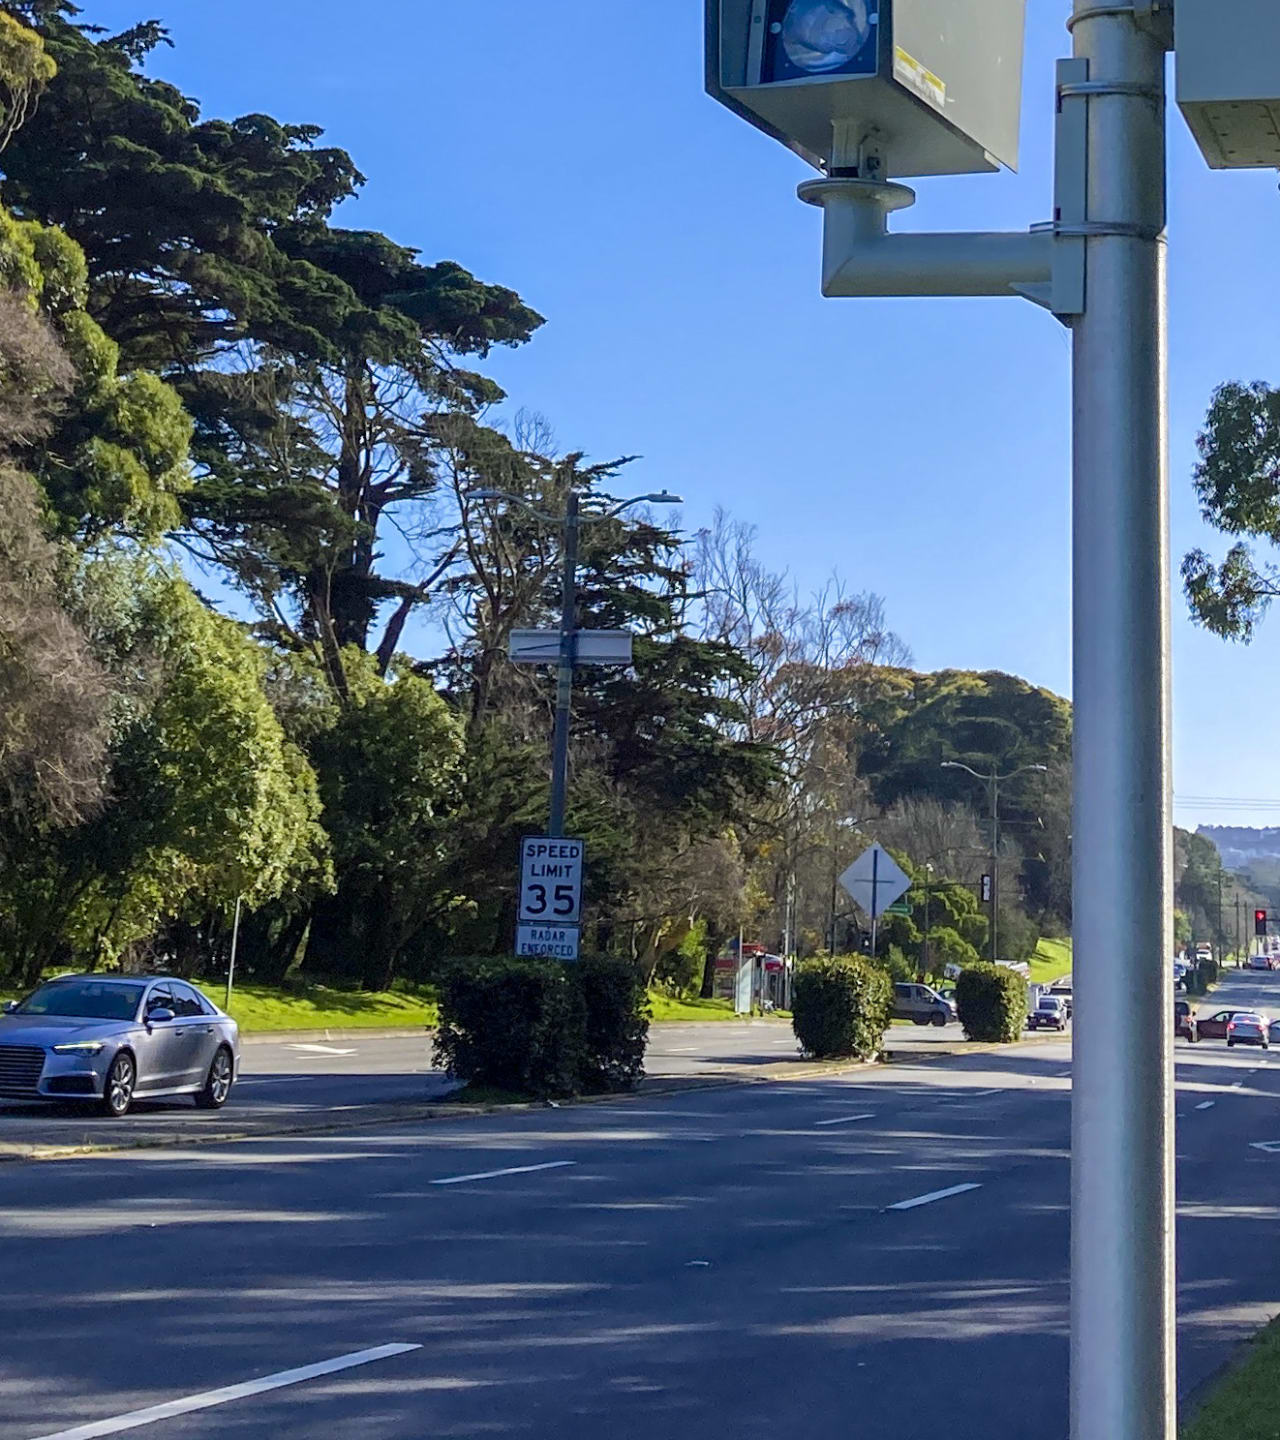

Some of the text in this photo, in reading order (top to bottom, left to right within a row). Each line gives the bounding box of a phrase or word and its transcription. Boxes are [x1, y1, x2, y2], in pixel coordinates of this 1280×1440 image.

[526, 844, 579, 858] SPEED
[531, 864, 573, 878] LIMIT
[525, 884, 574, 915] 35
[531, 929, 566, 942] RADAR
[521, 943, 574, 957] ENFORCED
